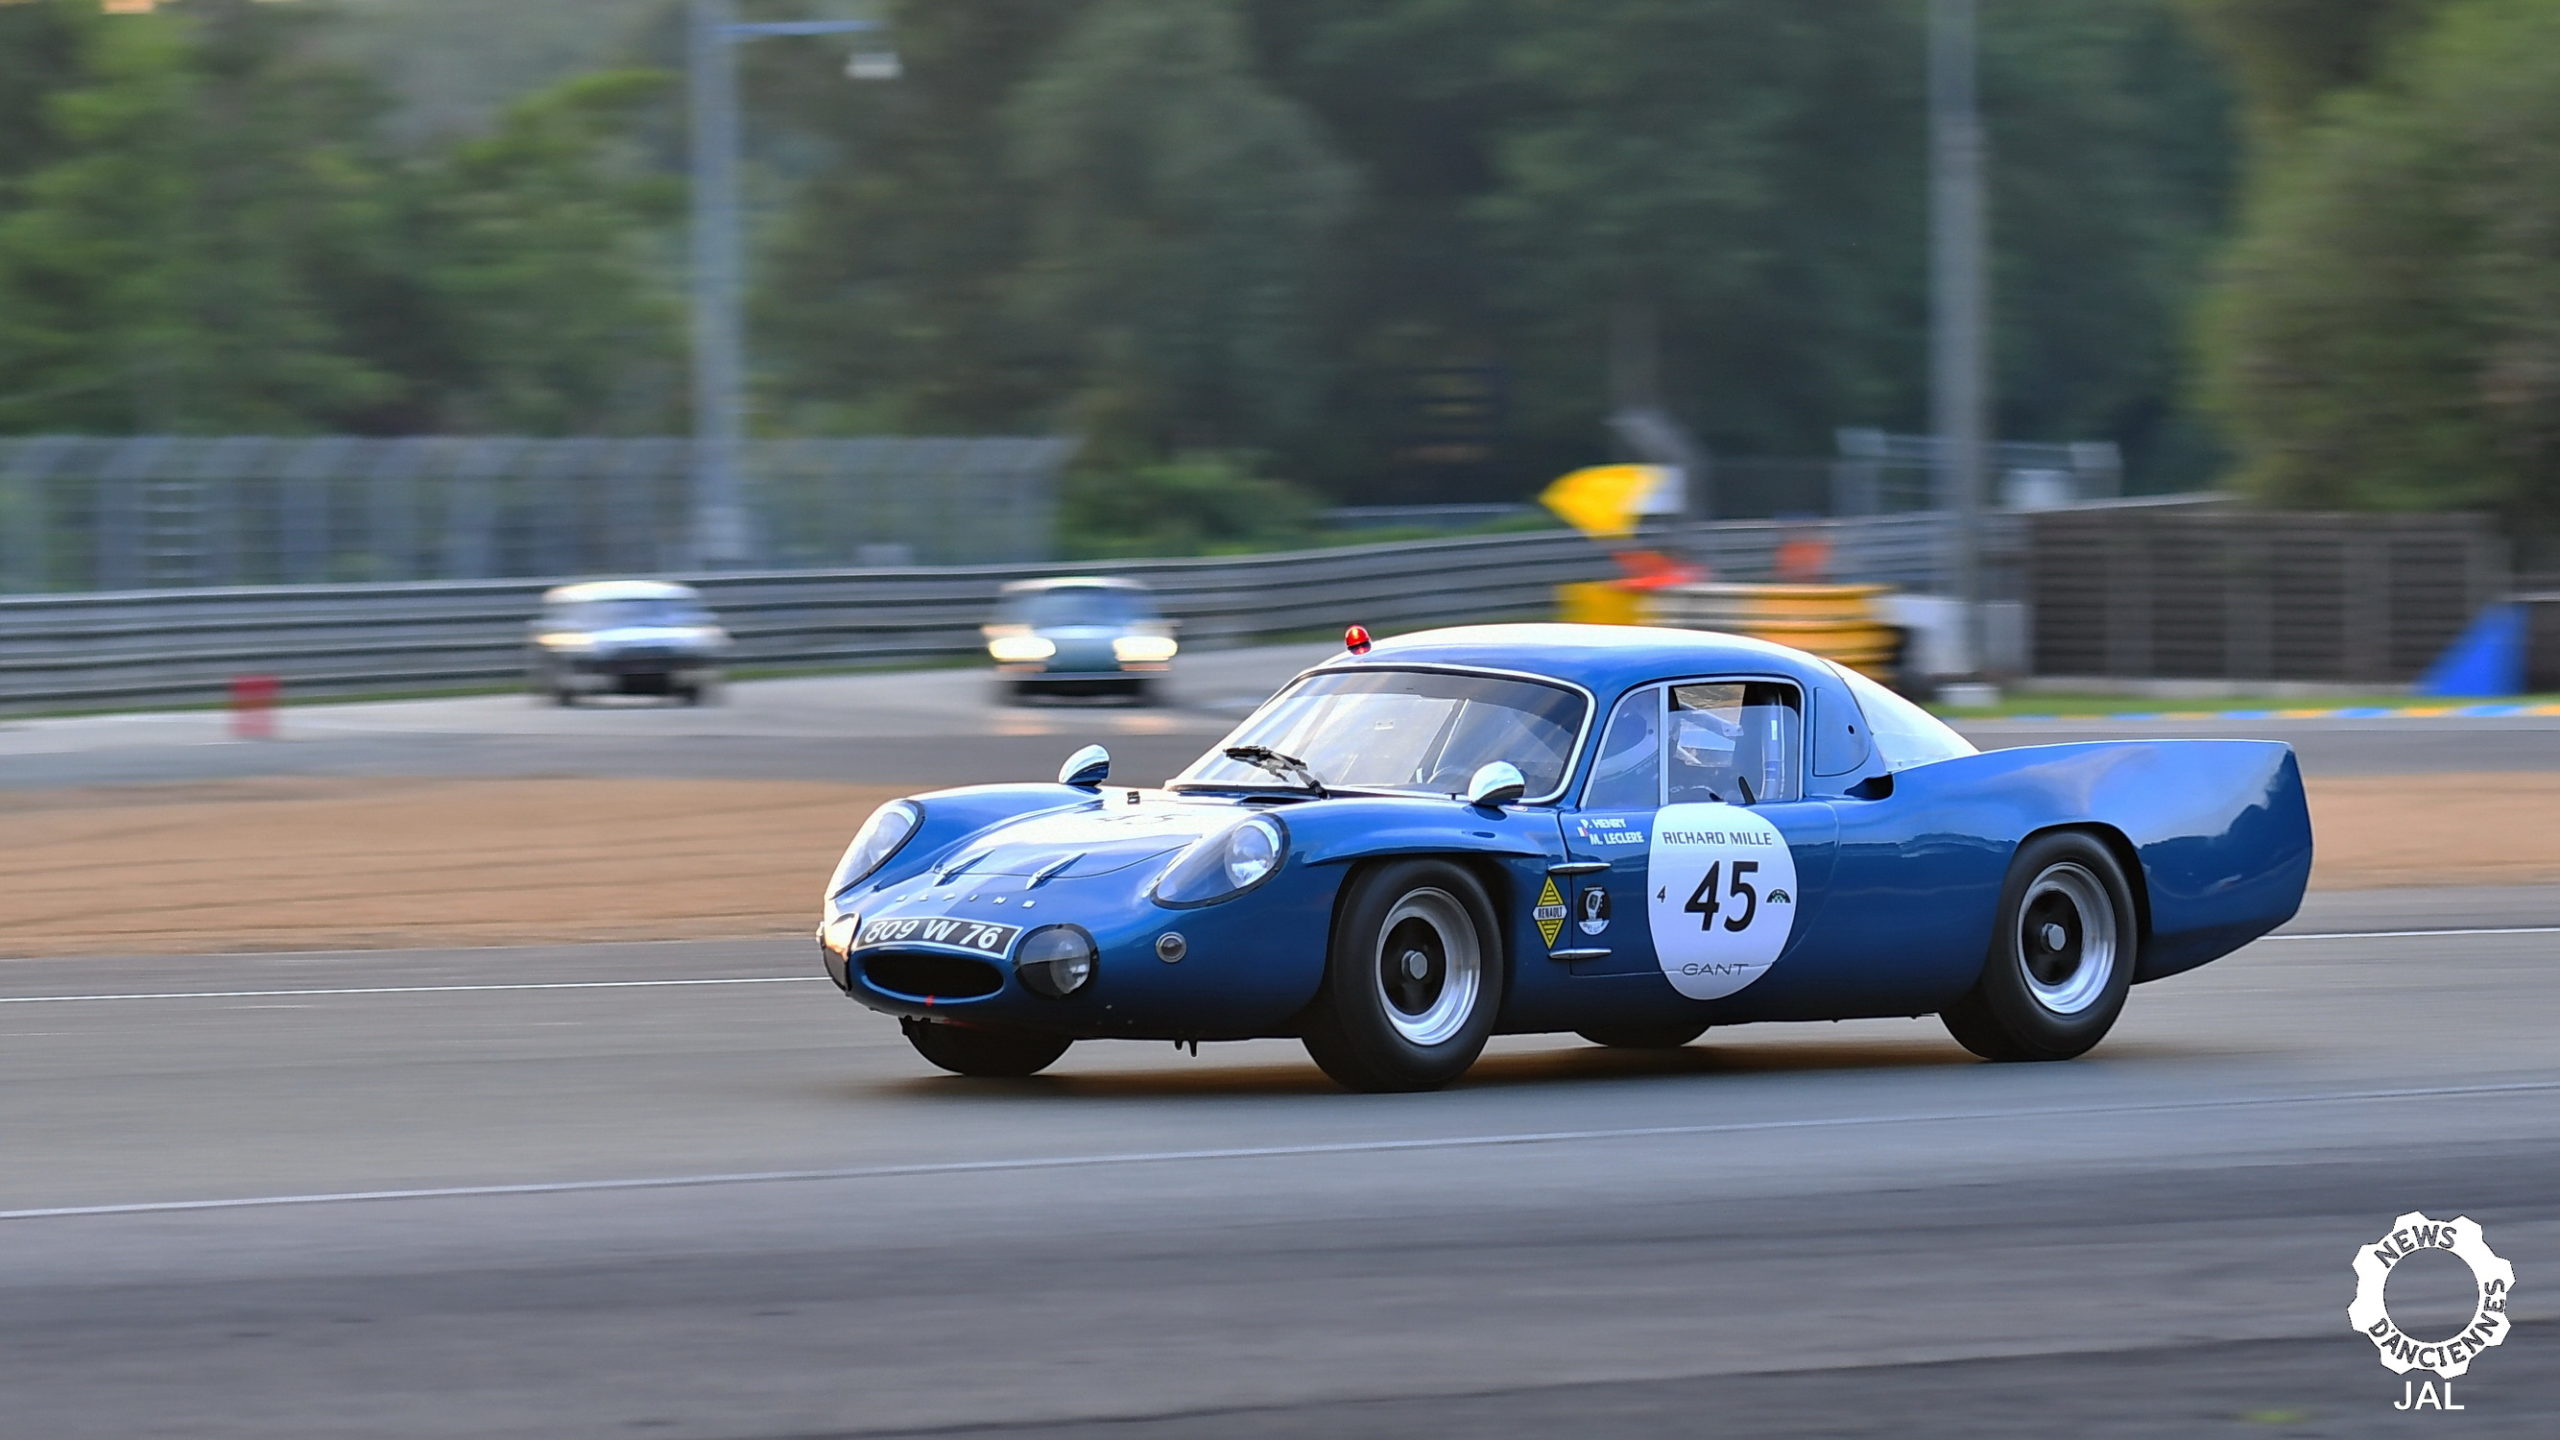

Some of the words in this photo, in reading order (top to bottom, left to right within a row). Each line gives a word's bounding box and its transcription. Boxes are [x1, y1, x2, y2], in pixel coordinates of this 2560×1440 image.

[1662, 831, 1726, 845] RICHARD
[1729, 832, 1773, 846] MILLE
[1656, 885, 1667, 904] 4
[1684, 860, 1759, 933] 45
[864, 920, 920, 944] 809
[922, 919, 962, 942] W
[959, 924, 1004, 949] 76
[1681, 963, 1749, 977] GANT
